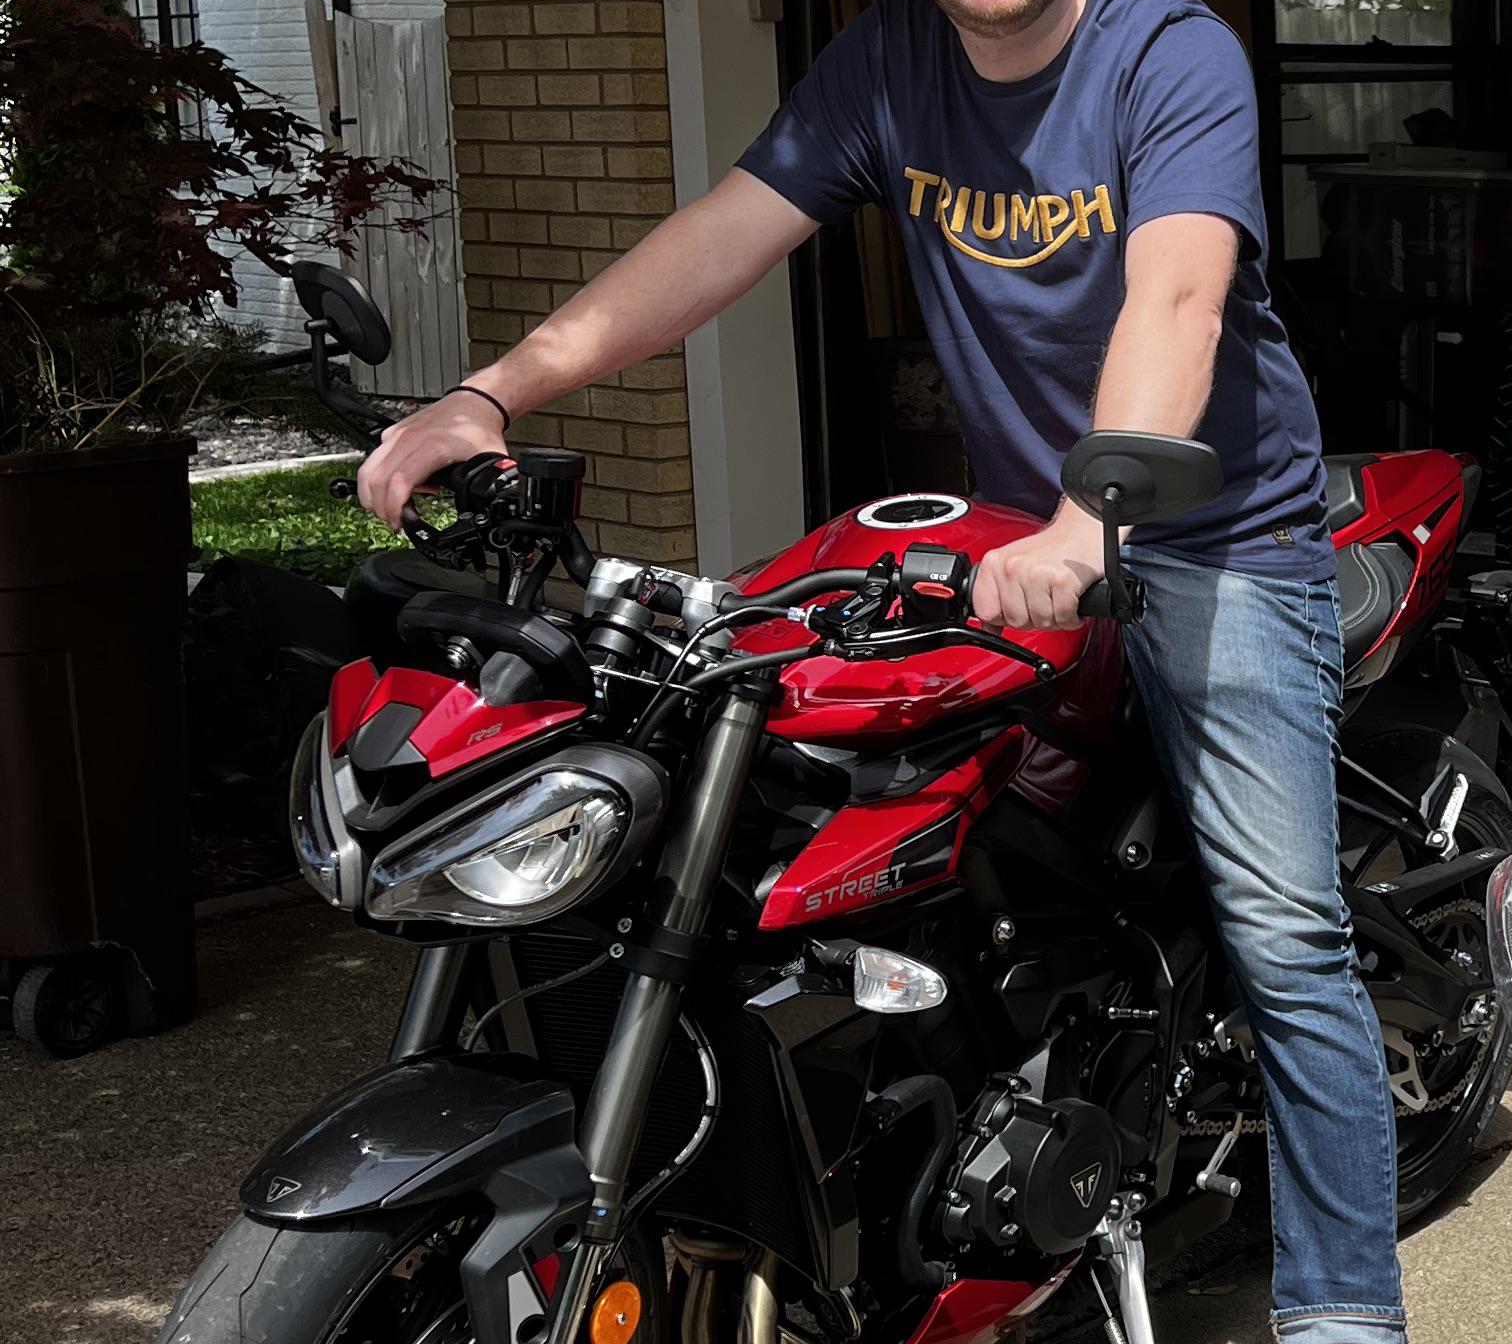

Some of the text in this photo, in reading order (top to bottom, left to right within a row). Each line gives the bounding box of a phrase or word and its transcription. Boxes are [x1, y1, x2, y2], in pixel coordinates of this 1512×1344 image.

[904, 166, 1117, 268] TRIUMPH
[804, 862, 906, 913] STREET
[863, 879, 904, 900] TRIPLE
